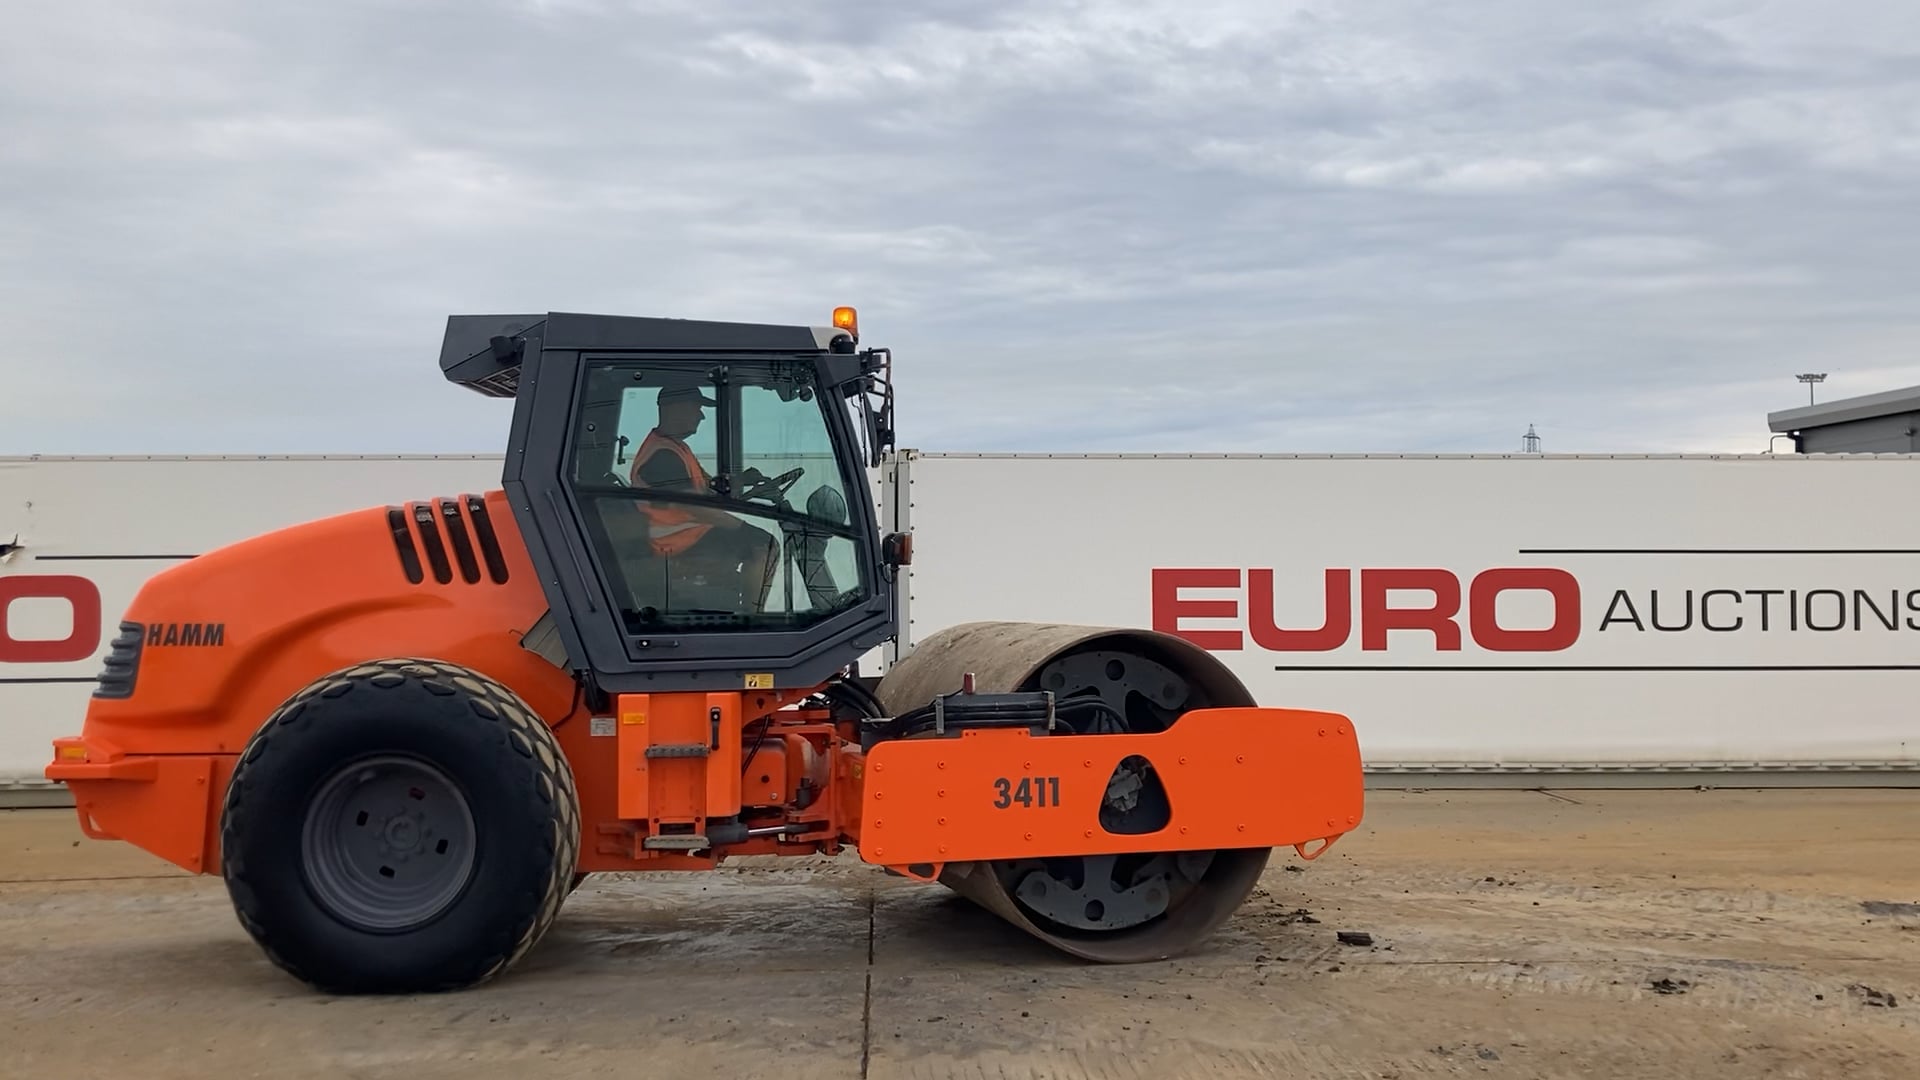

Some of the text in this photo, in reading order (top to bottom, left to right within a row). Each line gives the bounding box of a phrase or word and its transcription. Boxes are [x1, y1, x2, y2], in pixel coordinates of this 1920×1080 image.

[1152, 568, 1580, 651] EURO
[146, 623, 225, 647] HAMM
[993, 776, 1060, 810] 3411
